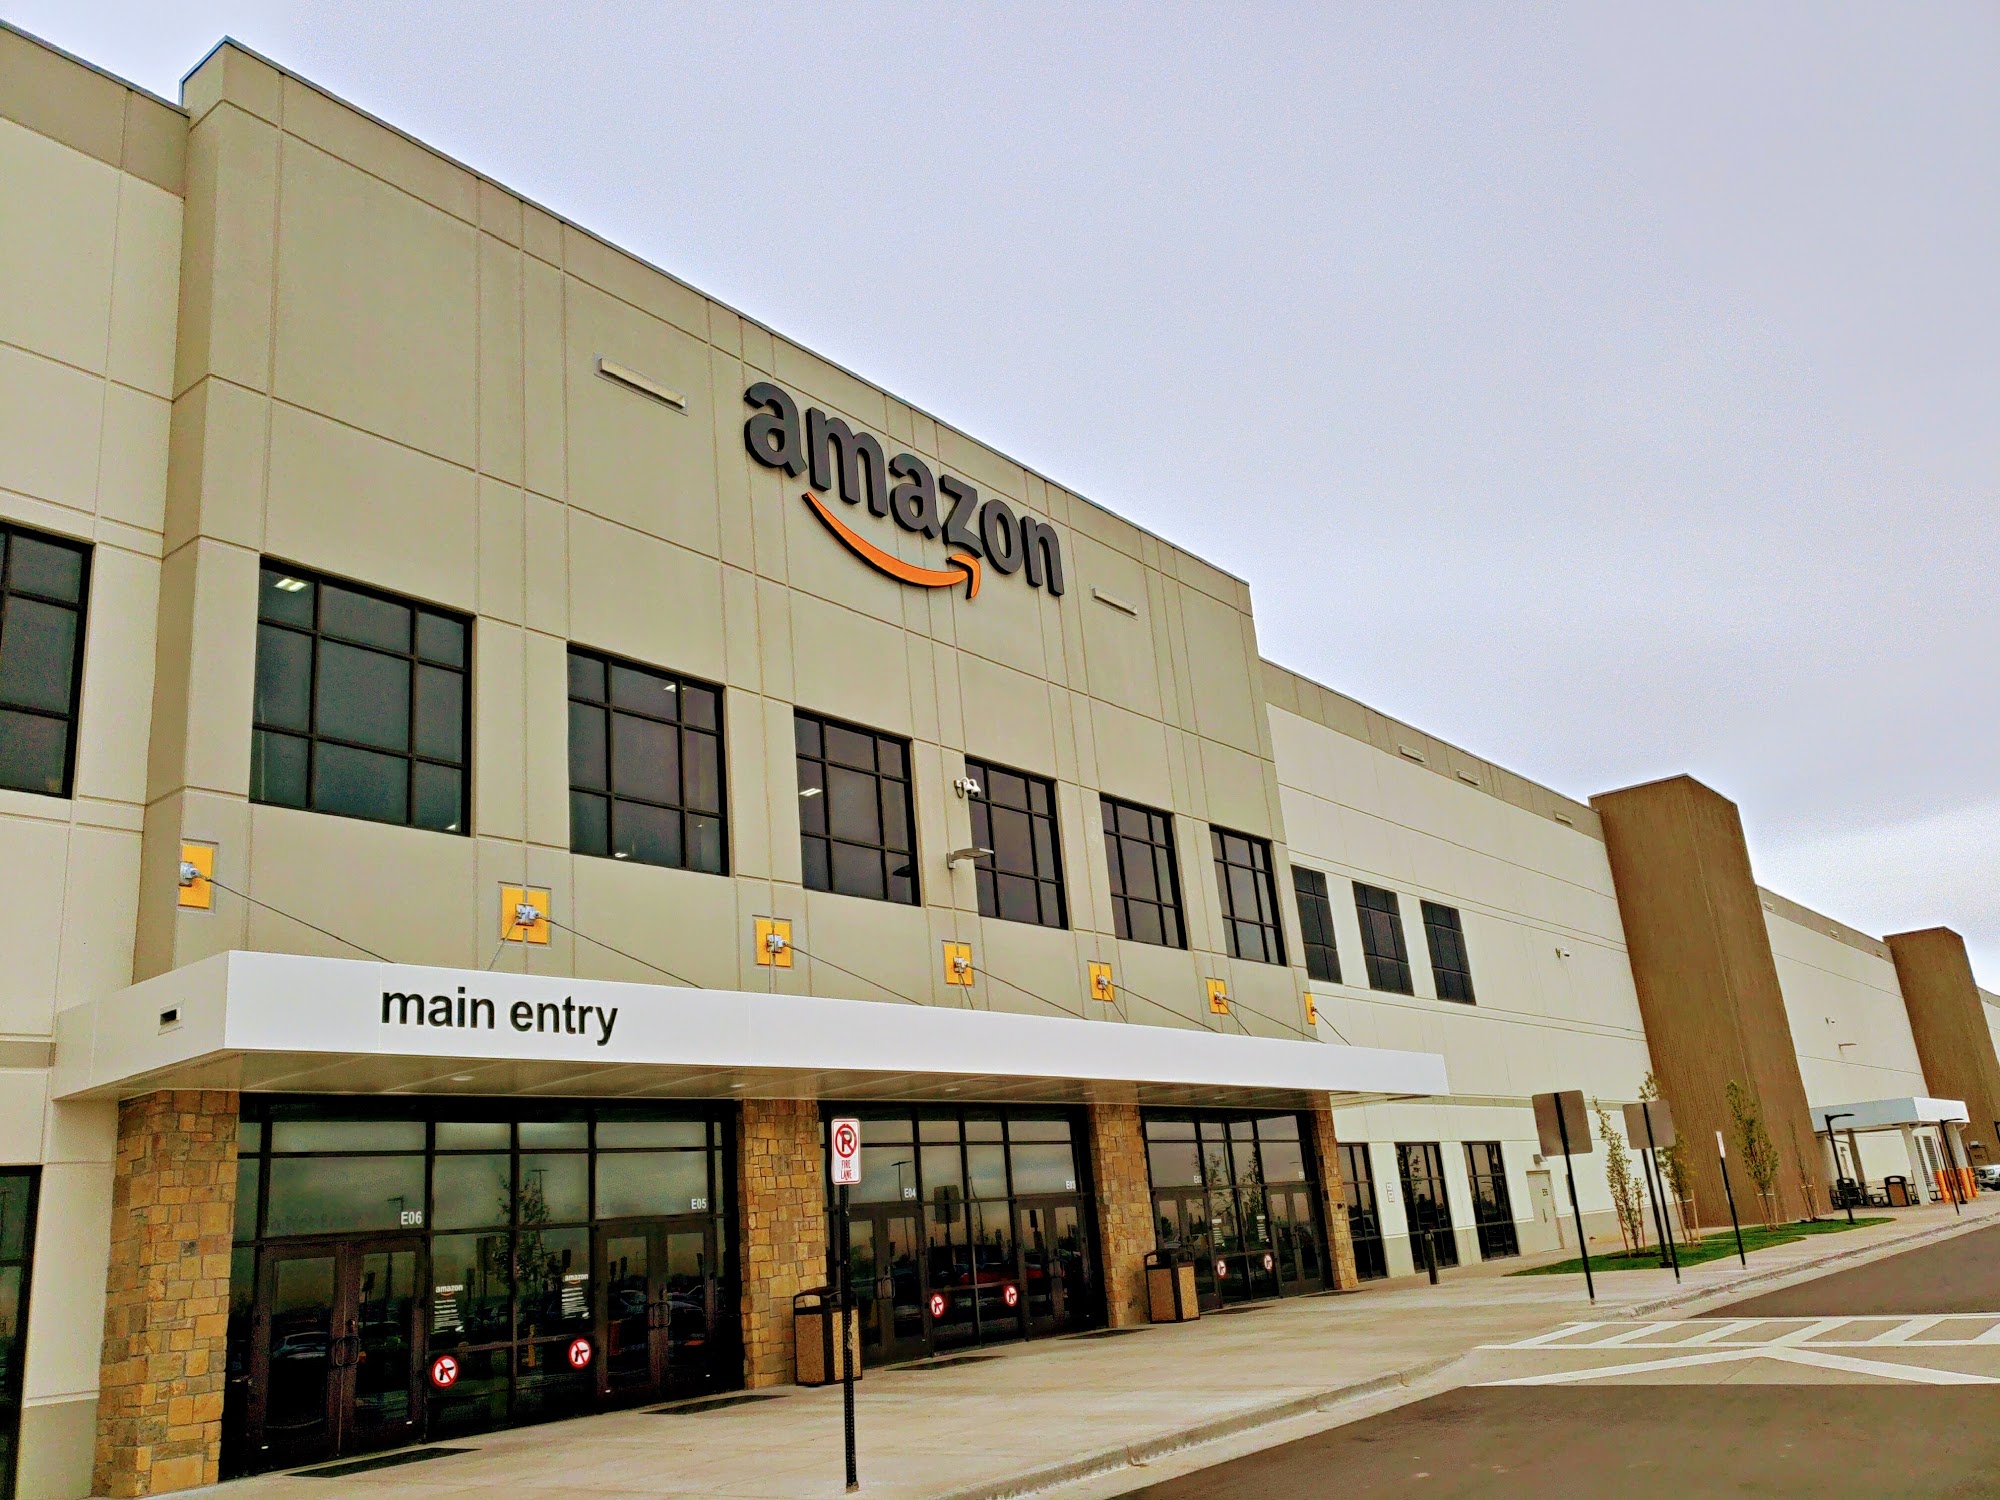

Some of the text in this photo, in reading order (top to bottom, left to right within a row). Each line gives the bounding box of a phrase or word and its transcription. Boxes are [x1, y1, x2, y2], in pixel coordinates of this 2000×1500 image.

[743, 381, 1065, 597] amazon
[381, 986, 618, 1047] main entry
[841, 1159, 851, 1168] FIRE
[840, 1169, 852, 1180] LANE
[904, 1187, 916, 1198] E04
[691, 1198, 707, 1210] E05
[400, 1210, 422, 1225] E06
[564, 1273, 589, 1281] amazon
[435, 1284, 464, 1293] amazon
